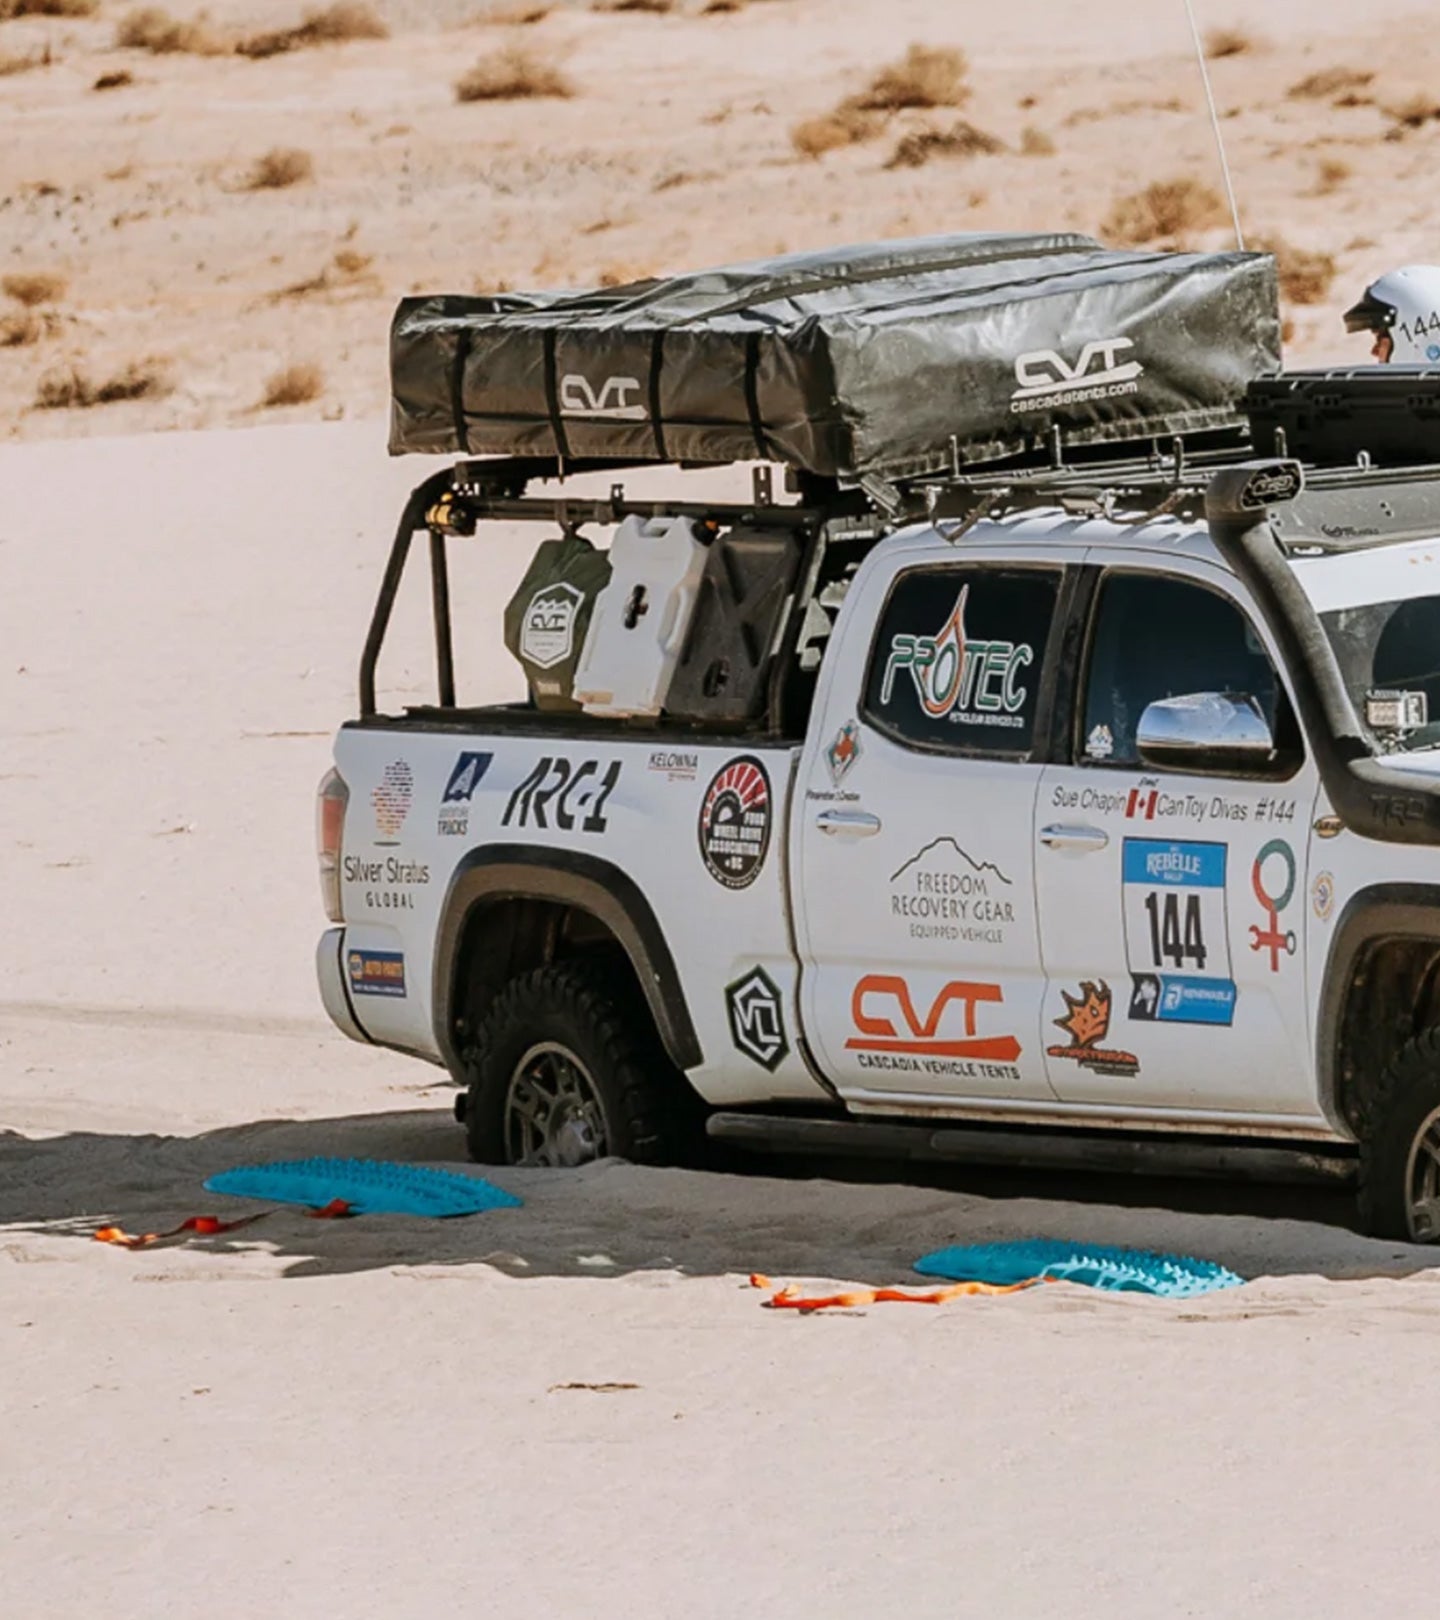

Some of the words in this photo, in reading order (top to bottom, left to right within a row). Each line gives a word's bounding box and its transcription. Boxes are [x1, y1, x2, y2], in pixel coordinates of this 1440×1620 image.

[1014, 337, 1135, 387] CVT
[561, 374, 641, 409] CVT
[1010, 381, 1138, 413] cascadiatents.com
[648, 752, 699, 768] KELOWNA
[1052, 786, 1078, 807] Sue
[1080, 788, 1126, 815] Chapin
[1156, 793, 1206, 822] CanToy
[1209, 797, 1249, 821] Divas
[1254, 797, 1297, 823] #144
[344, 855, 383, 883] Silver
[387, 856, 431, 885] Stratus
[1146, 851, 1202, 877] REBELLE
[917, 872, 988, 897] FREEDOM
[365, 891, 415, 909] GLOBAL
[891, 894, 968, 920] RECOVERY
[973, 900, 1015, 922] GEAR
[910, 922, 959, 940] EQUIPPED
[960, 926, 1004, 944] VEHICLE
[1144, 891, 1207, 970] 144
[852, 974, 1004, 1038] CVT
[857, 1053, 922, 1073] CASCADIA
[922, 1059, 978, 1078] VEHICLE
[978, 1063, 1021, 1080] TENTS
